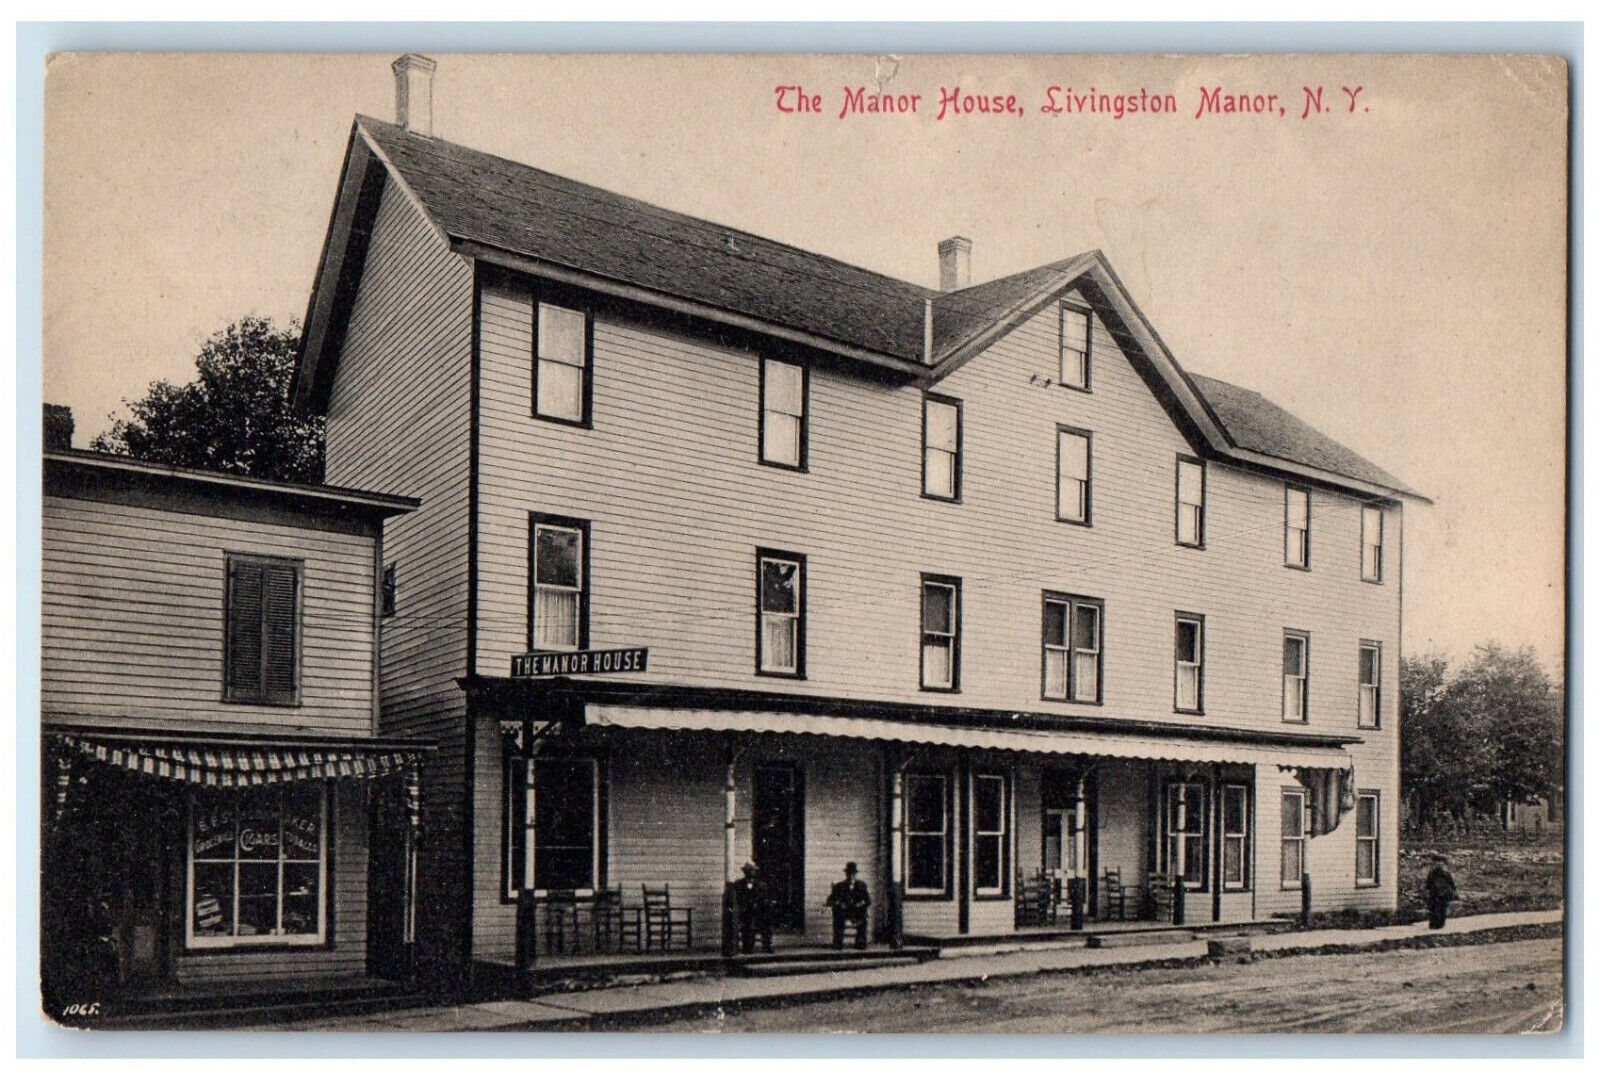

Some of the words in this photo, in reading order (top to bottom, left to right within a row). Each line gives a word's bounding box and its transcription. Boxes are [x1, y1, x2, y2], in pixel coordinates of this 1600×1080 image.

[516, 657, 540, 675] THE
[542, 654, 588, 674] MANOR
[593, 651, 642, 672] HOUSE
